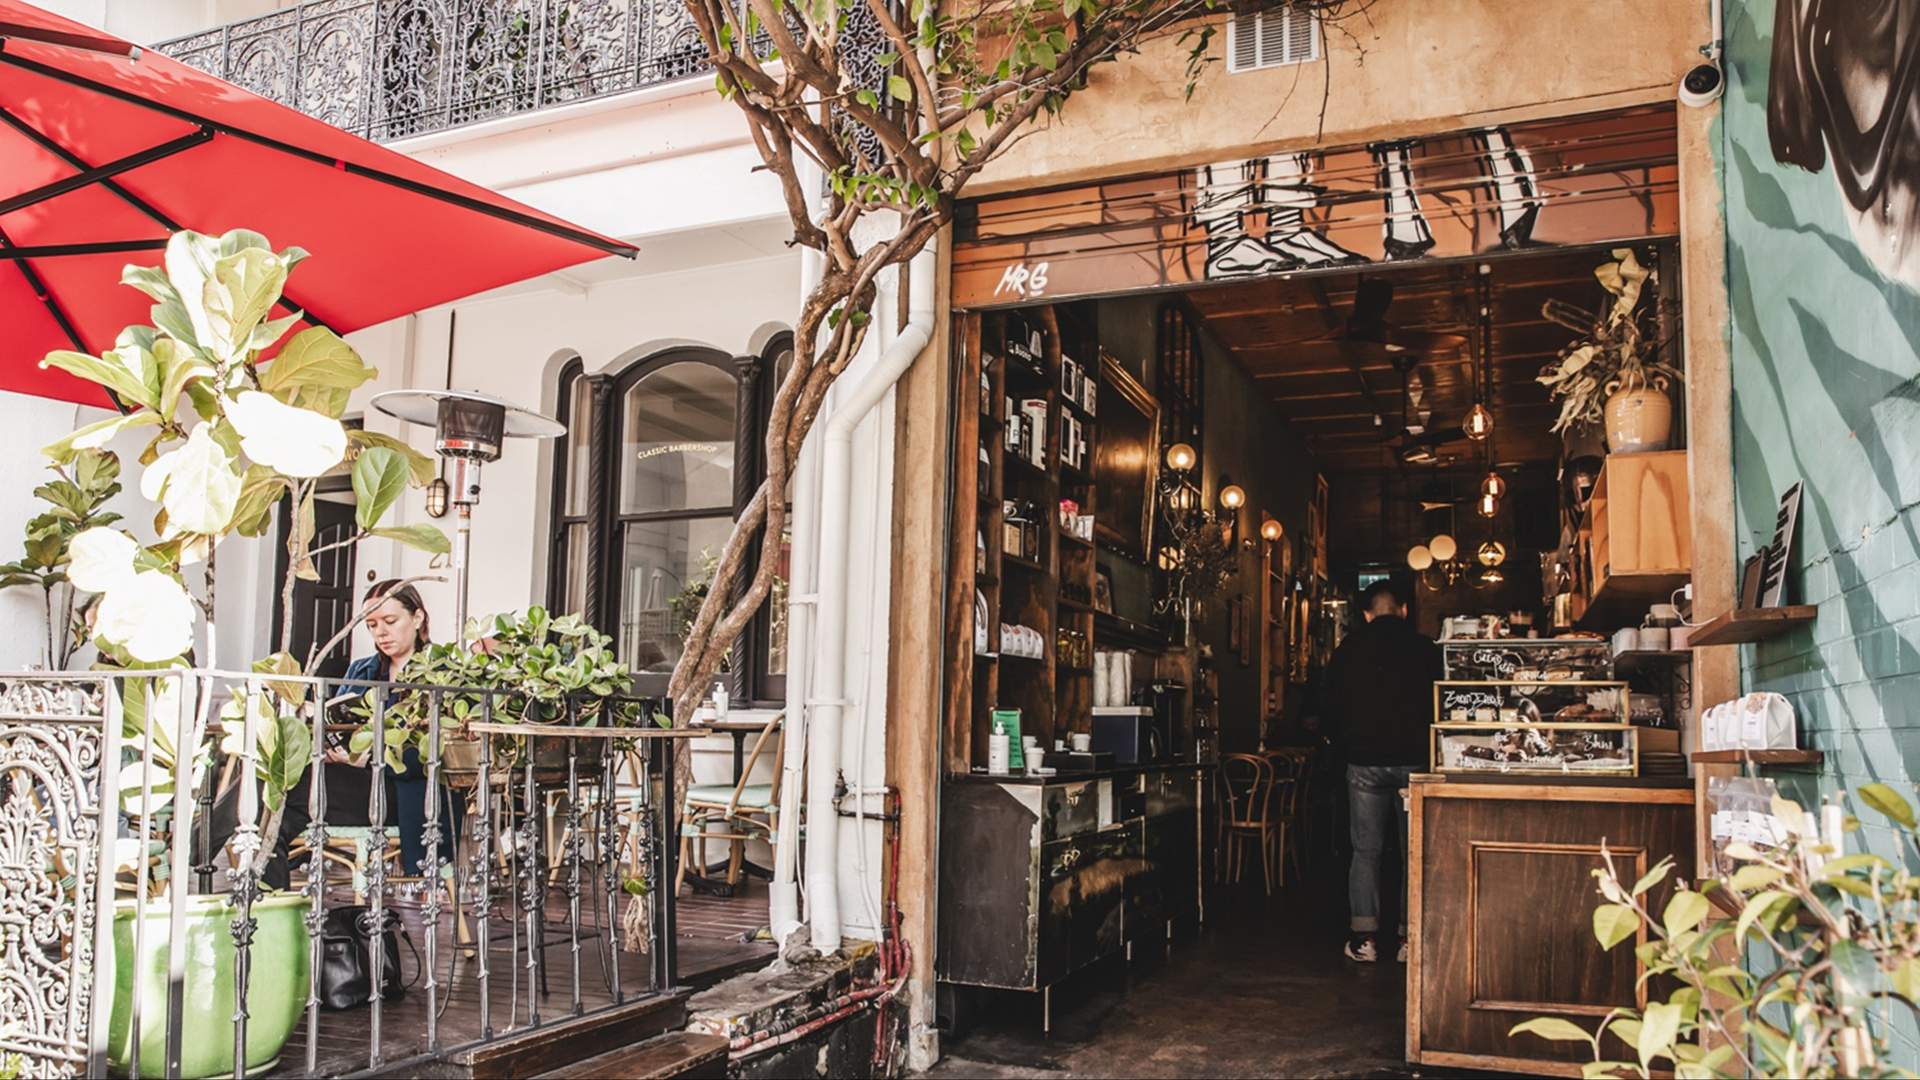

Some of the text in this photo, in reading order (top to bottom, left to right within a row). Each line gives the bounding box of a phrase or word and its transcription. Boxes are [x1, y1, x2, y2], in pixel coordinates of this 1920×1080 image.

[994, 263, 1029, 296] MR
[637, 443, 718, 459] CLASSIC BARBERSHOP
